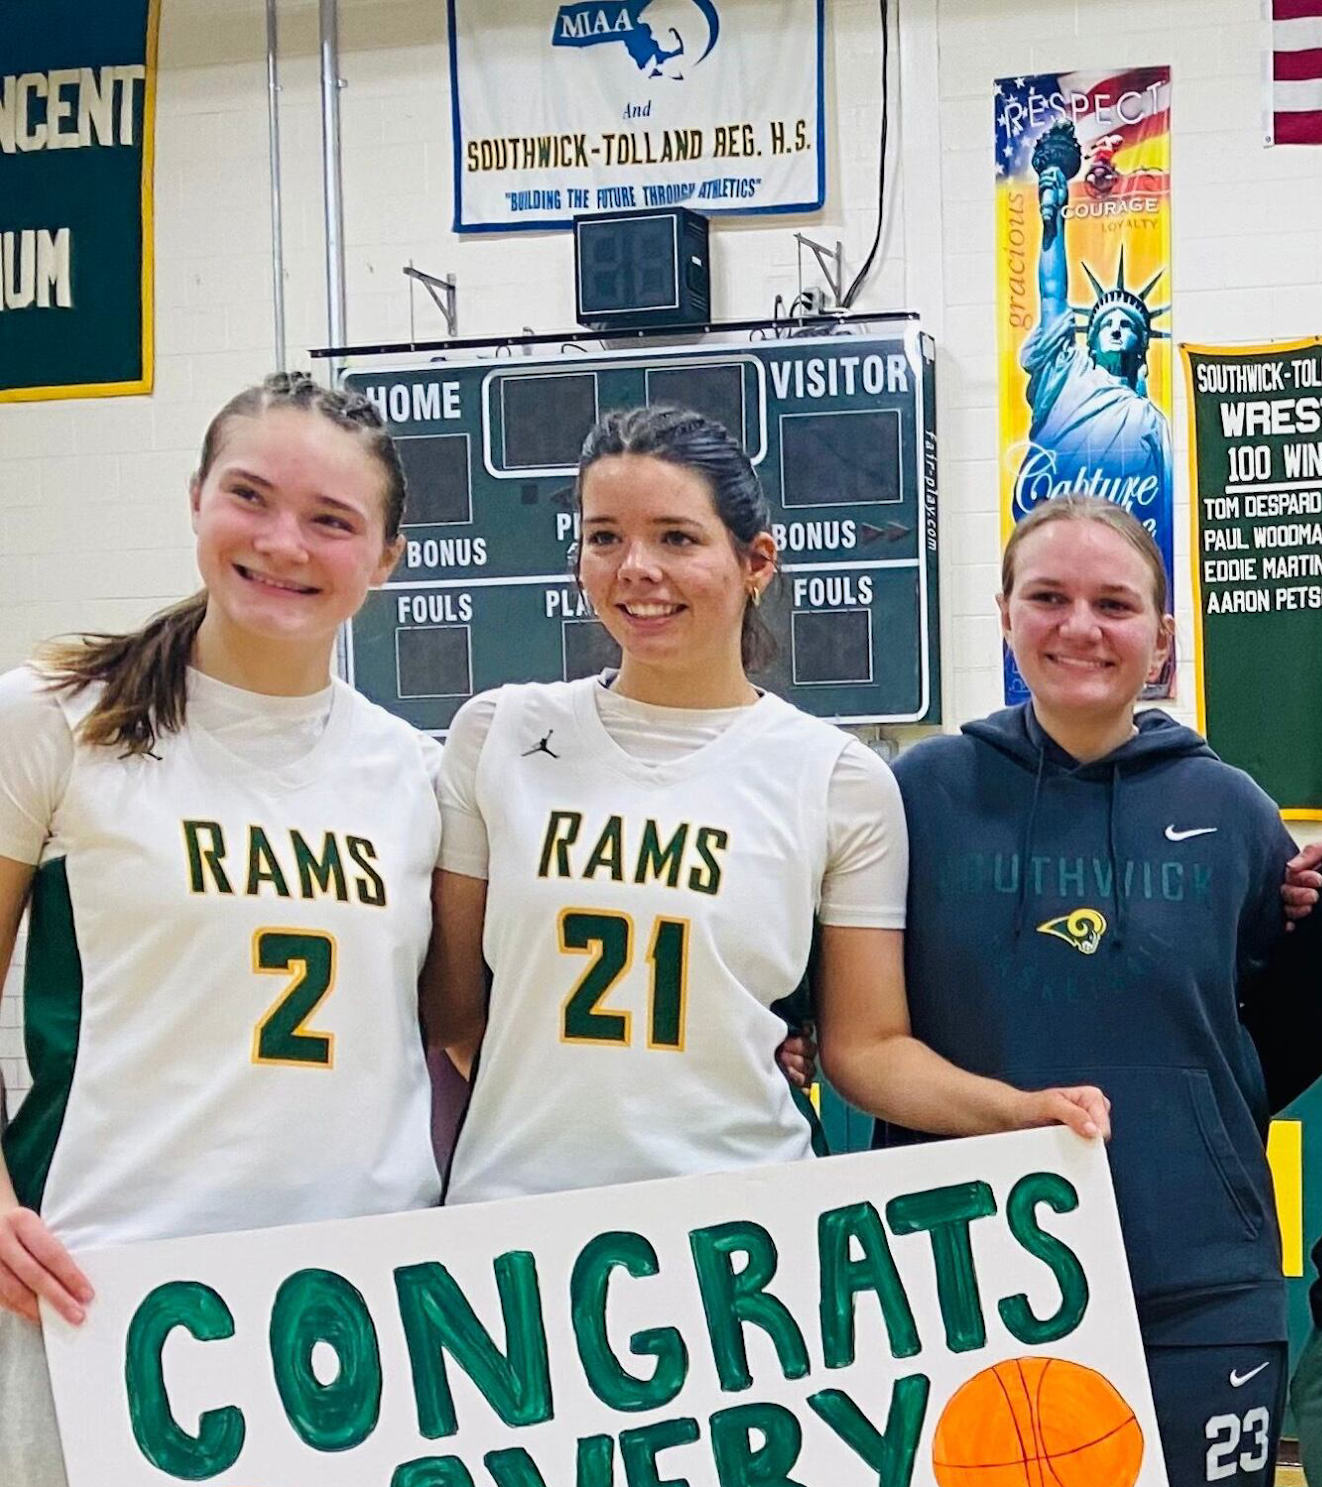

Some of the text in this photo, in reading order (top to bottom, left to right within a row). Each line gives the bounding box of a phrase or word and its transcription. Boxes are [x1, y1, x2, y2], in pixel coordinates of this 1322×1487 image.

[560, 8, 632, 38] MIAA
[622, 100, 652, 120] And
[1003, 81, 1167, 138] RESPECT
[468, 120, 812, 173] SOUTHWICK-TOLLAND REG. H.S.
[567, 188, 590, 210] THE
[597, 186, 636, 209] FUTURE
[1060, 197, 1159, 219] COURAGE
[1101, 219, 1159, 233] LOYALTY
[1009, 192, 1034, 331] gracious
[769, 353, 909, 400] VISITOR
[366, 381, 462, 423] HOME
[1227, 445, 1271, 483] 100
[923, 429, 939, 552] fair-play.com
[1203, 496, 1240, 521] TOM
[1244, 491, 1322, 518] DESPARD
[407, 537, 488, 568] BONUS
[771, 519, 857, 552] BONUS
[1203, 527, 1250, 552] PAUL
[1204, 558, 1257, 583] EDDIE
[398, 592, 474, 624] FOULS
[793, 575, 874, 607] FOULS
[1206, 589, 1271, 615] AARON
[182, 818, 388, 907] RAMS
[536, 808, 729, 897] RAMS
[251, 925, 338, 1069] 2
[557, 906, 691, 1052] 21
[124, 1171, 1092, 1482] CONGRATS
[1205, 1406, 1270, 1481] 23
